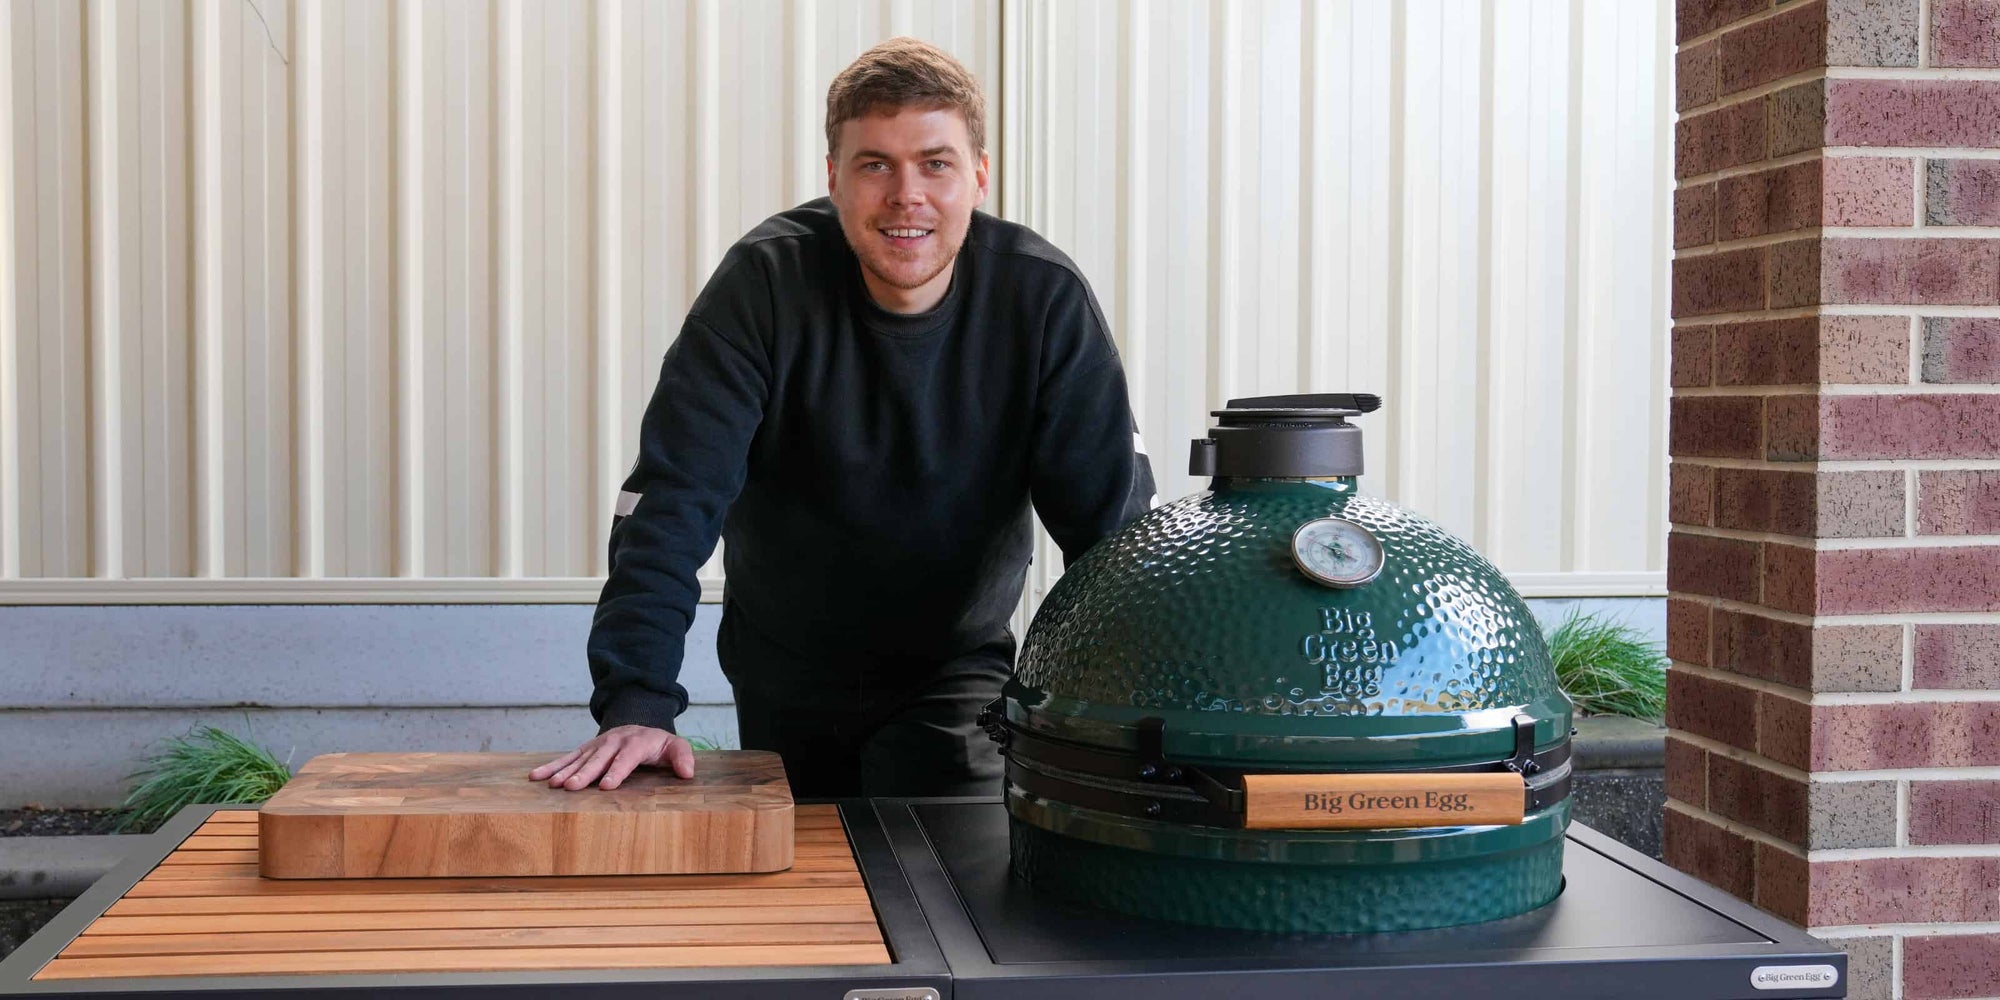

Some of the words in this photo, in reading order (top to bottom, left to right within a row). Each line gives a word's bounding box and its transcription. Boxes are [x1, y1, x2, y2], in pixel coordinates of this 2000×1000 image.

[1320, 607, 1375, 640] Big
[1301, 634, 1400, 665] Green
[1321, 662, 1382, 698] Egg
[1304, 793, 1342, 814] Big
[1348, 792, 1419, 809] Green
[1765, 973, 1779, 983] Big
[1780, 972, 1804, 981] Green
